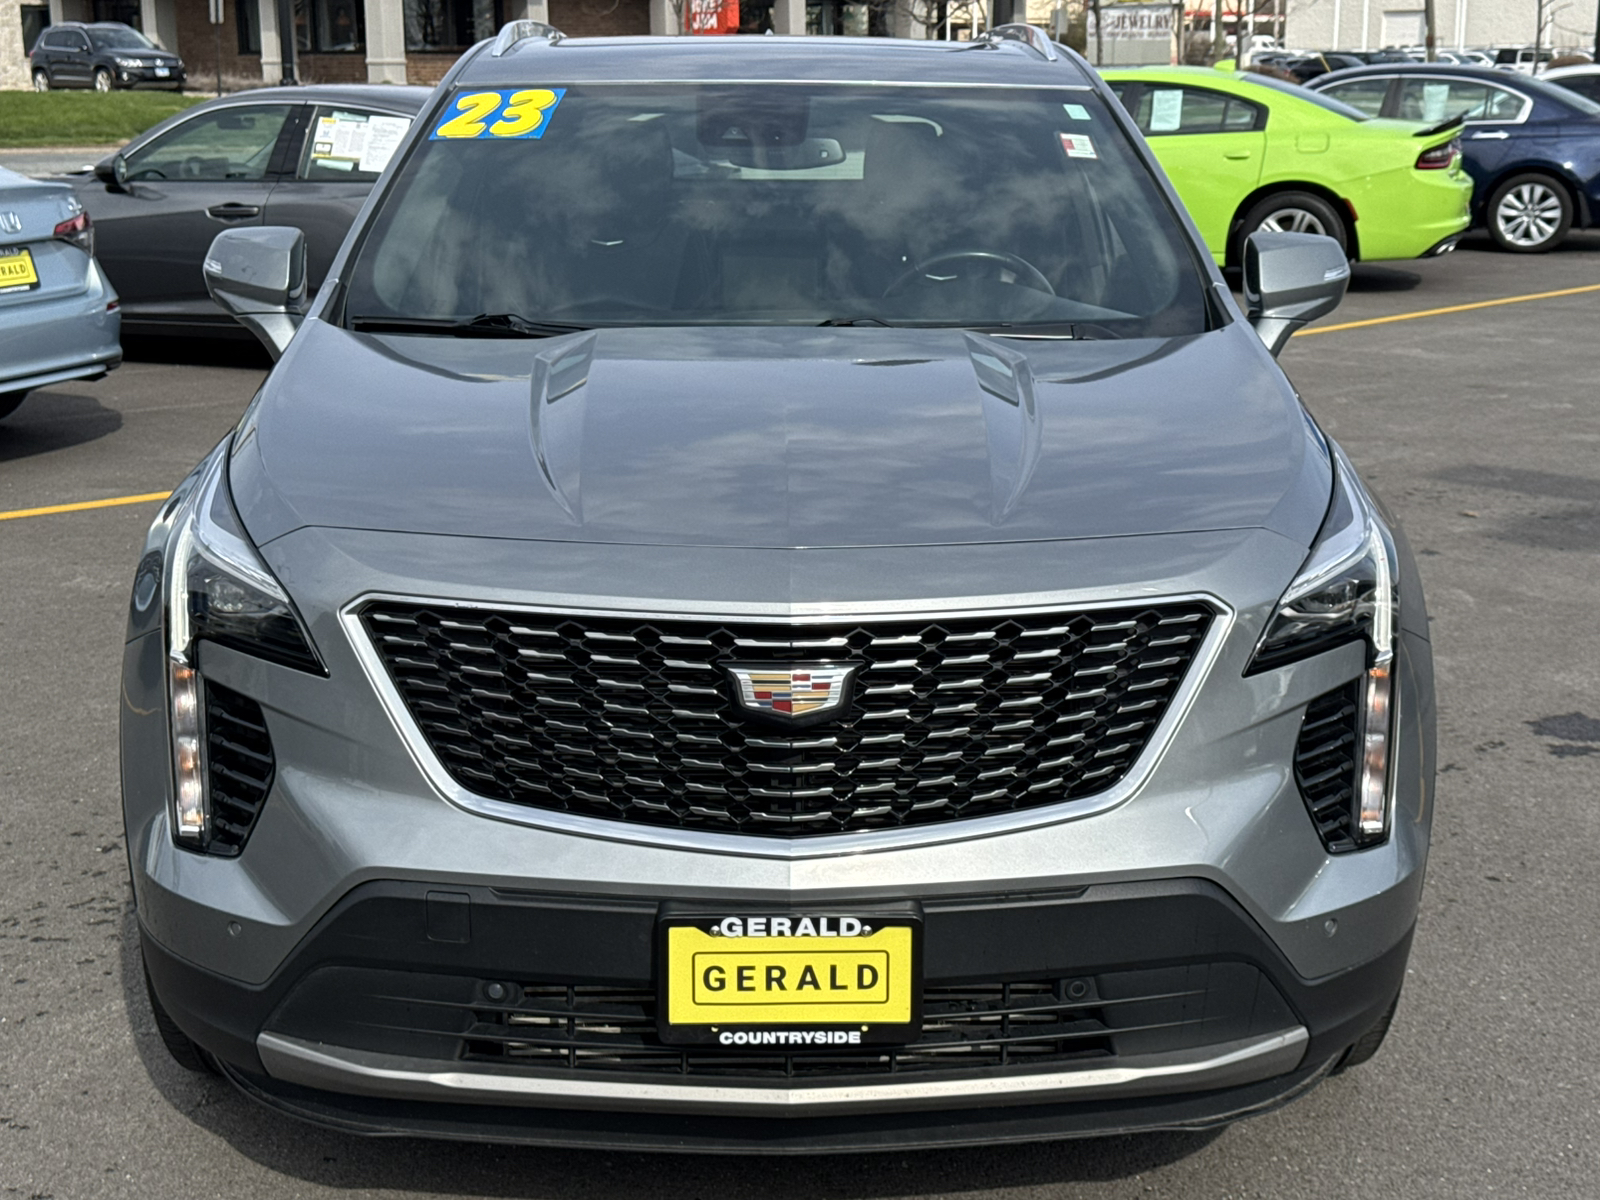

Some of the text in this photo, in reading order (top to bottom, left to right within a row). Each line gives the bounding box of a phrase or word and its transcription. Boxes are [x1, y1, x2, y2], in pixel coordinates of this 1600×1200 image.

[1114, 13, 1170, 29] JEWELRY
[436, 89, 557, 138] 23
[720, 916, 862, 938] GERALD
[702, 964, 879, 992] GERALD
[718, 1031, 861, 1045] COUNTRYSIDE
